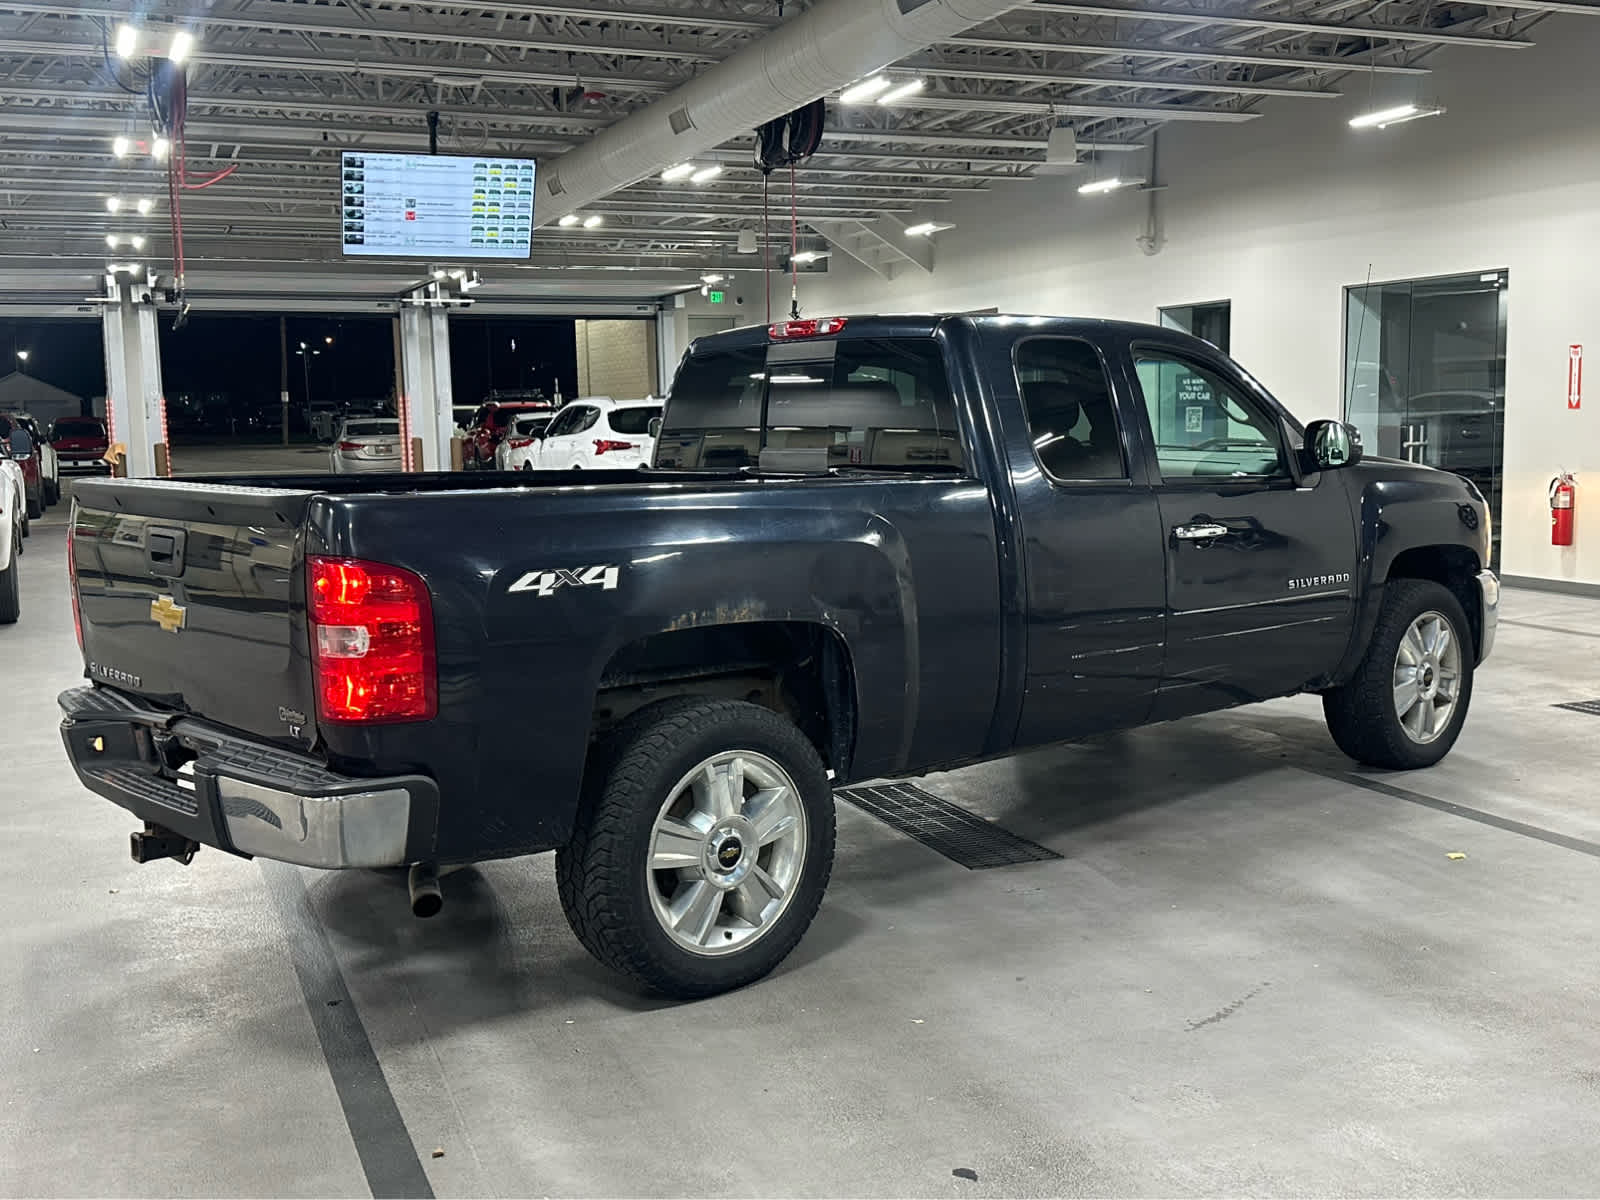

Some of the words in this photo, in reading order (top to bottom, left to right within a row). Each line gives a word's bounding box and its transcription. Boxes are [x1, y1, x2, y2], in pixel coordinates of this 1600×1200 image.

[1179, 391, 1196, 400] YOUR
[1196, 391, 1210, 400] CAR
[1288, 573, 1350, 590] SILVERADO
[90, 662, 142, 688] SILVERADO
[290, 725, 300, 739] LT
